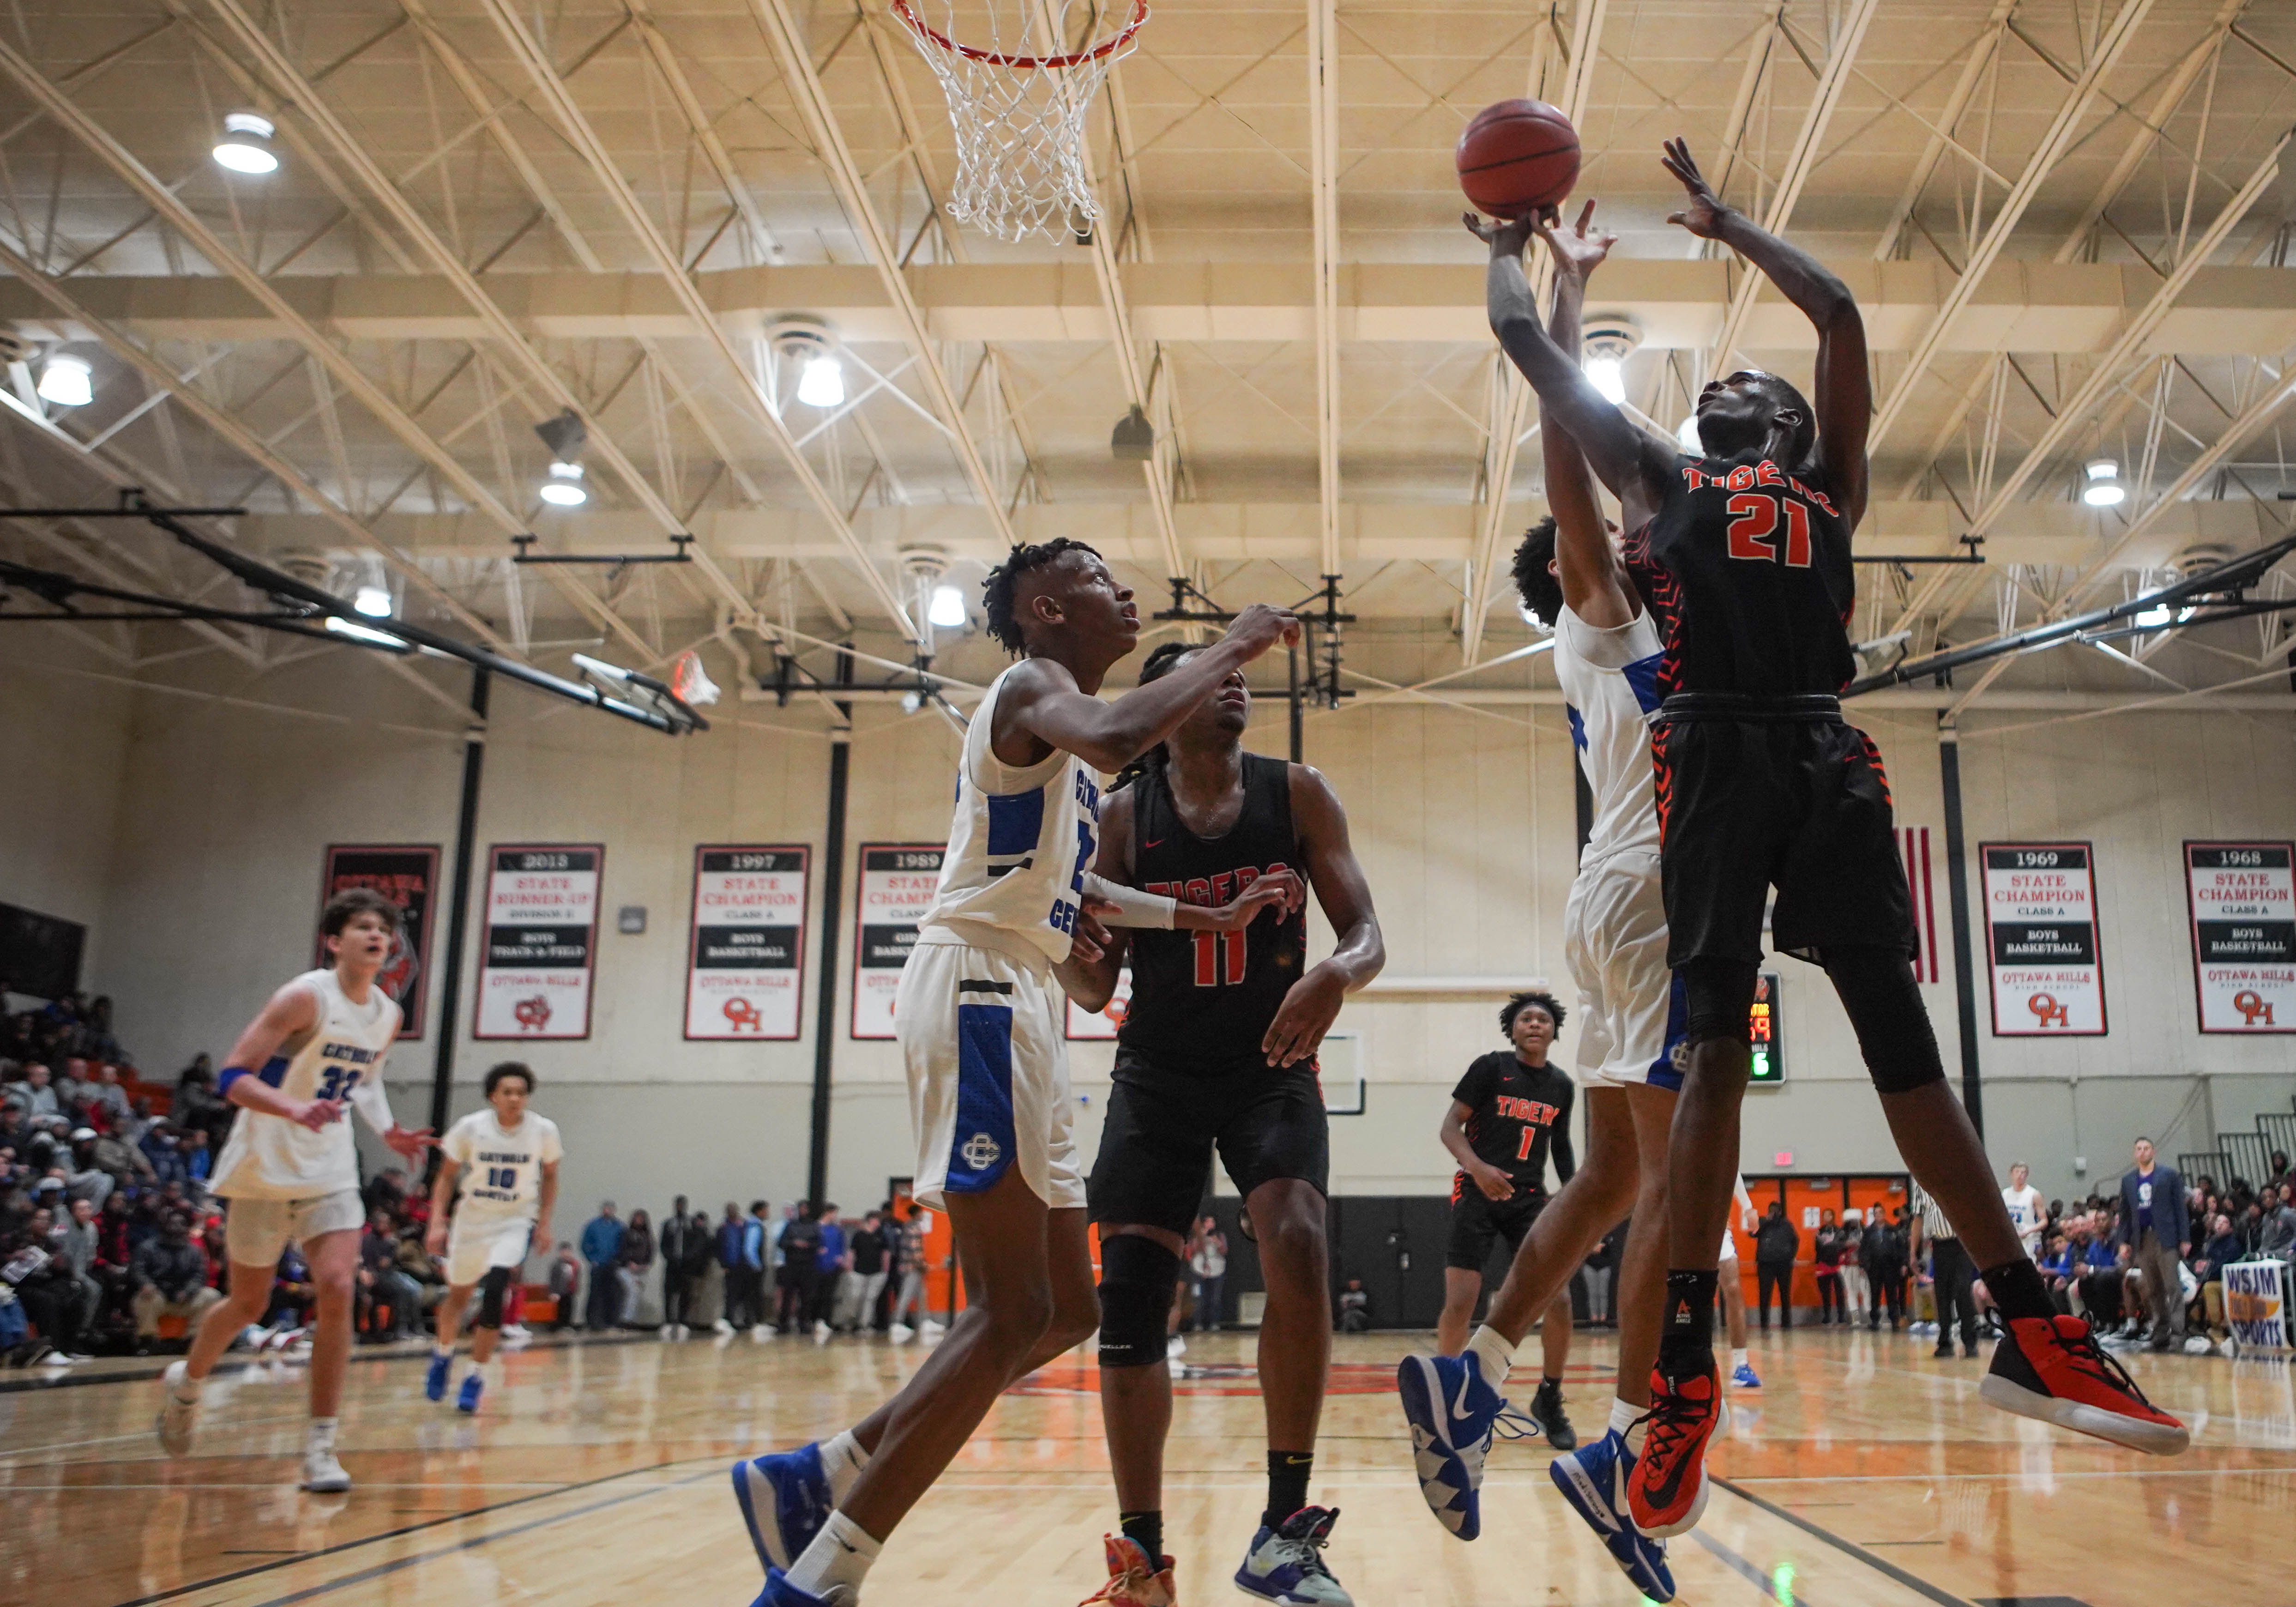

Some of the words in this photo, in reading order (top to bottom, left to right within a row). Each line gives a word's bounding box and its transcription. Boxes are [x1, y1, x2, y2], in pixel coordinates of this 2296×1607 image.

[1726, 493, 1811, 568] 21
[731, 854, 777, 869] 1997
[2016, 852, 2058, 866] 1969
[2220, 851, 2261, 866] 1968
[724, 878, 780, 889] STATE
[2011, 875, 2066, 887] STATE
[2215, 873, 2270, 886] STATE
[703, 893, 797, 905] CHAMPION
[1995, 890, 2085, 902] CHAMPION
[2199, 888, 2288, 901] CHAMPION
[2018, 907, 2054, 916] CLASS
[2058, 907, 2065, 916] A
[2222, 905, 2257, 914] CLASS
[2261, 906, 2268, 914] A
[2027, 930, 2059, 941] BOYS
[2232, 928, 2263, 940] BOYS
[2006, 942, 2082, 955] BASKETBALL
[2211, 941, 2286, 953] BASKETBALL
[1191, 928, 1247, 986] 11
[2003, 972, 2052, 984] OTTAWA
[2056, 972, 2091, 984] HILLS
[2208, 970, 2257, 982] OTTAWA
[2260, 970, 2295, 983] HILLS
[1753, 1052, 1769, 1075] 6
[1517, 1126, 1536, 1160] 1
[2226, 1267, 2278, 1295] WSJM
[2232, 1318, 2283, 1347] SPORTS
